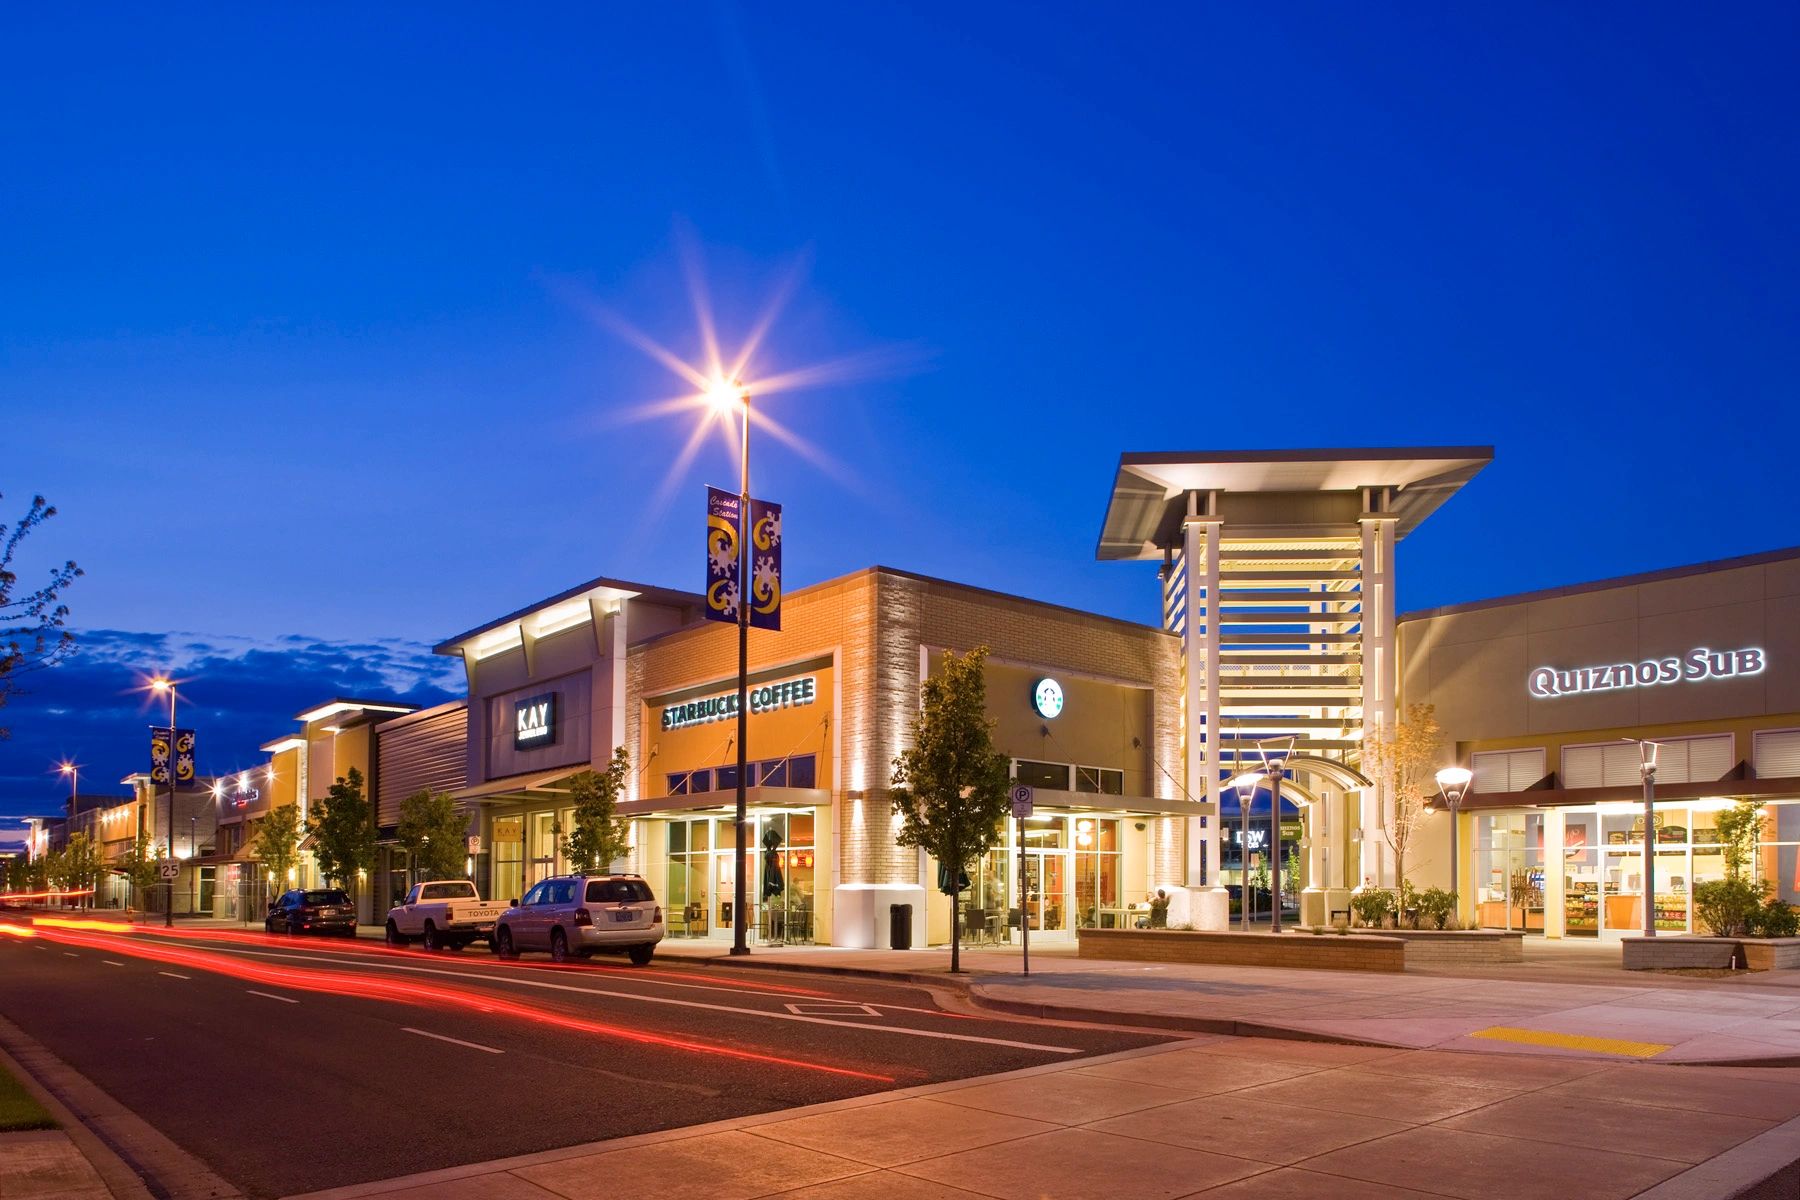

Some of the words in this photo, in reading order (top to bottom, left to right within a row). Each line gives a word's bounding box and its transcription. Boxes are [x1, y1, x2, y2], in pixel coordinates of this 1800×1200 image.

[710, 496, 738, 508] Cascade
[713, 508, 739, 519] Station
[750, 677, 815, 709] COFFEE
[518, 702, 548, 731] KAY
[162, 864, 179, 877] 25
